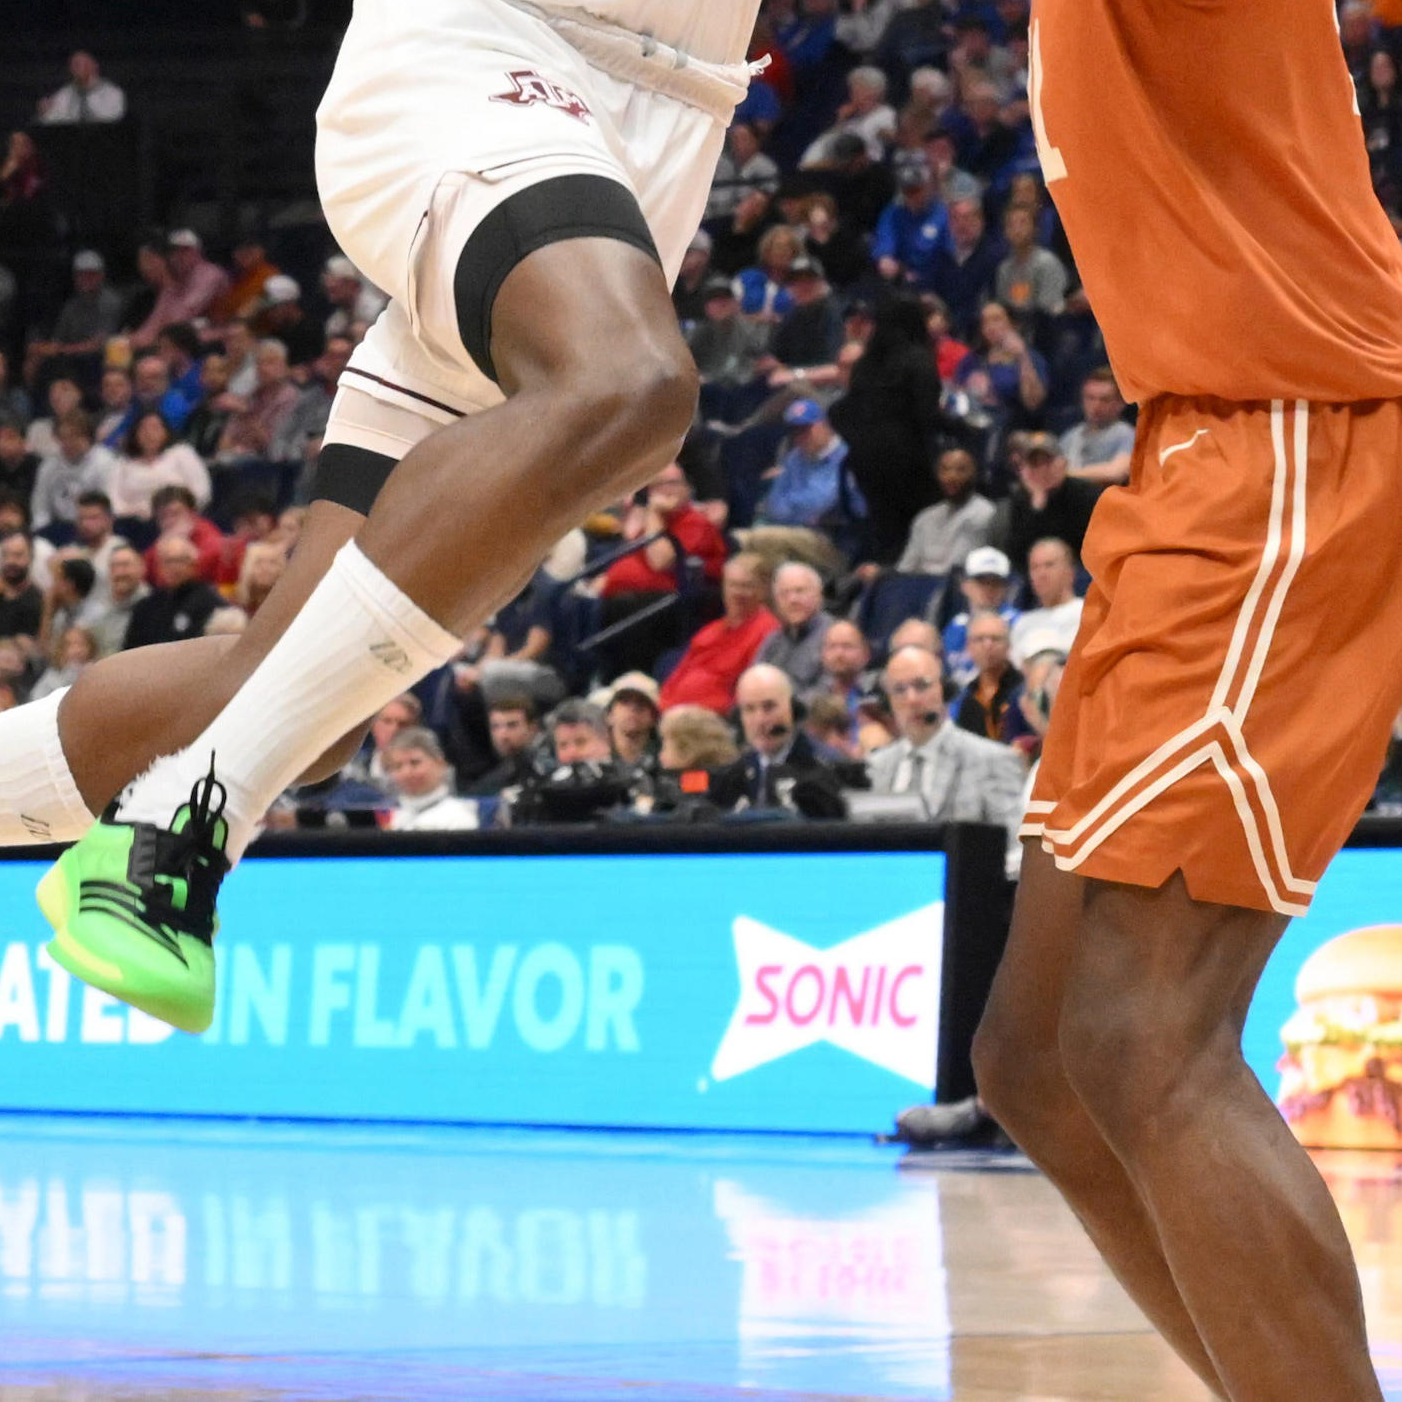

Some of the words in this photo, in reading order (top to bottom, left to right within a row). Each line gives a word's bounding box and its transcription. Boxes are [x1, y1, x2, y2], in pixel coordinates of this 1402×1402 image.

[202, 942, 292, 1046] IN
[308, 940, 646, 1053] FLAVOR
[745, 964, 924, 1028] SONIC
